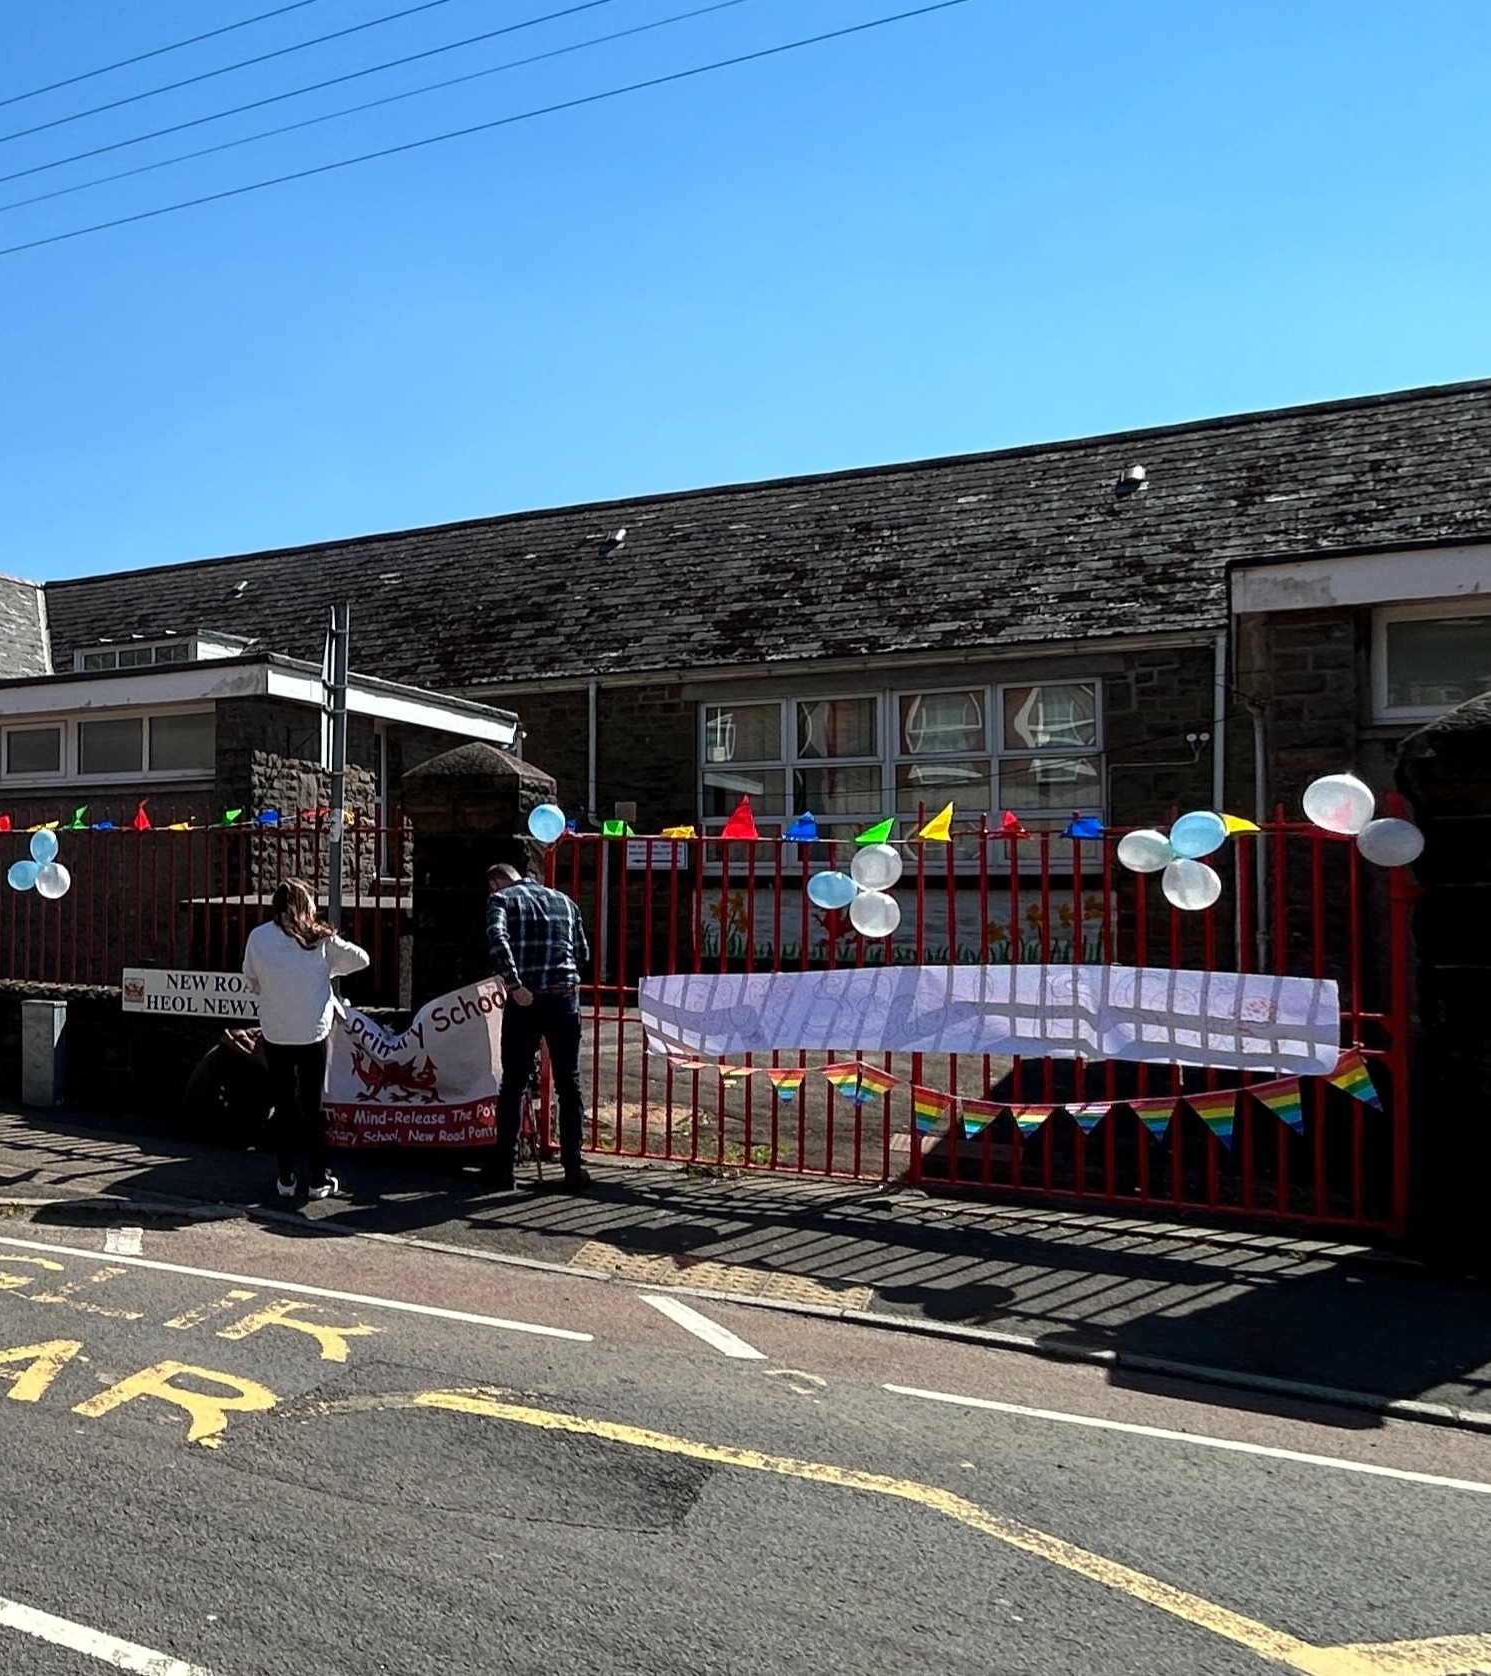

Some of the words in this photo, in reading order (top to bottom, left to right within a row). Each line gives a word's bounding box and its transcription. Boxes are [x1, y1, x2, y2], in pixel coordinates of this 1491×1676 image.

[166, 973, 210, 991] NEW
[214, 975, 261, 995] ROA
[146, 994, 198, 1013] HEOL
[203, 997, 260, 1017] NEWY
[431, 991, 506, 1033] Schoo
[322, 1107, 348, 1122] The
[353, 1109, 446, 1125] Mind-Release
[452, 1109, 473, 1123] The
[476, 1102, 497, 1119] Pot
[407, 1129, 435, 1142] New
[438, 1127, 466, 1142] Road
